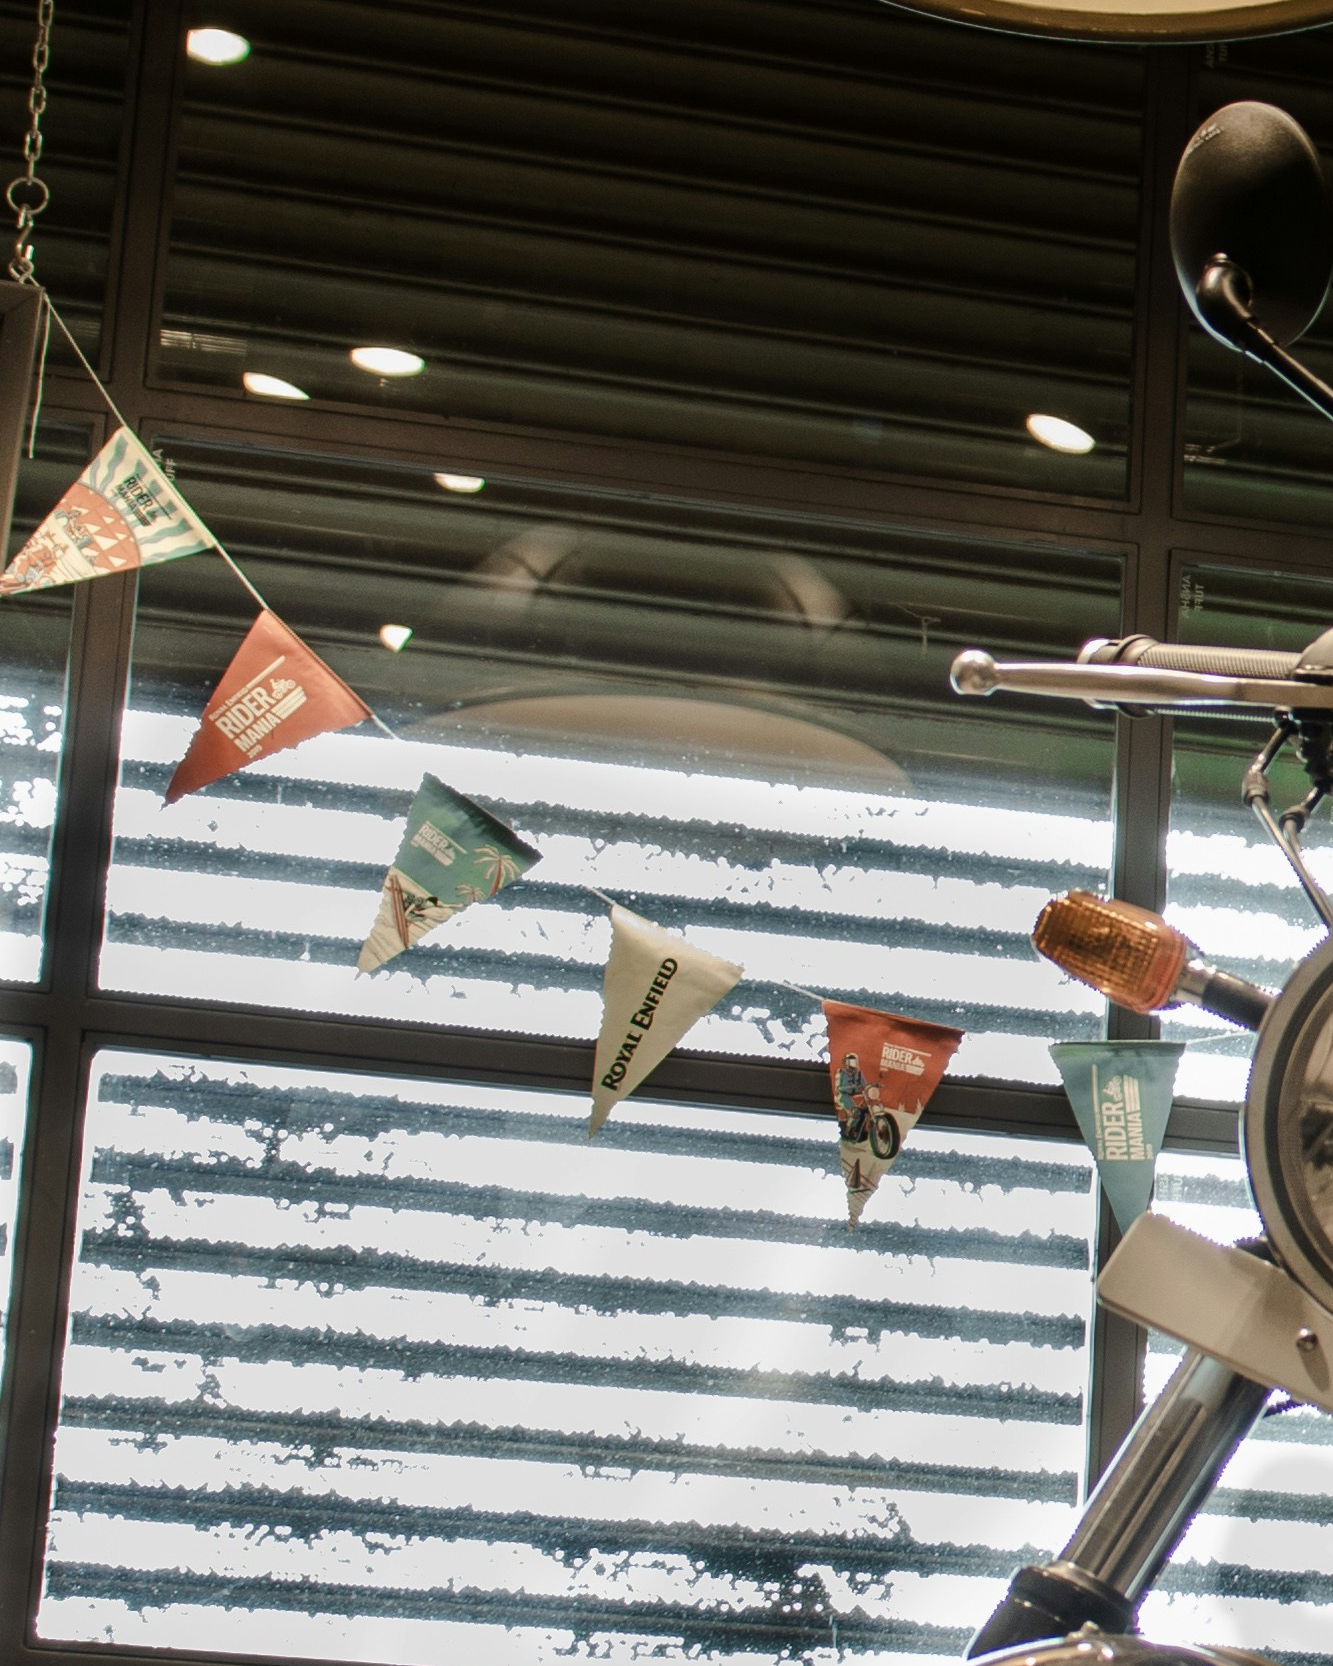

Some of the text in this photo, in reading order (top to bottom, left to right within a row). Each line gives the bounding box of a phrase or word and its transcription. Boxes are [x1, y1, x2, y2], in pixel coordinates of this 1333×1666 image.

[215, 687, 277, 740] RIDER
[233, 712, 281, 752] MANIA
[601, 958, 678, 1091] ROYAL ENFIELD
[882, 1046, 914, 1064] RIDER
[1102, 1101, 1129, 1160] RIDER
[1127, 1112, 1146, 1160] MANIA
